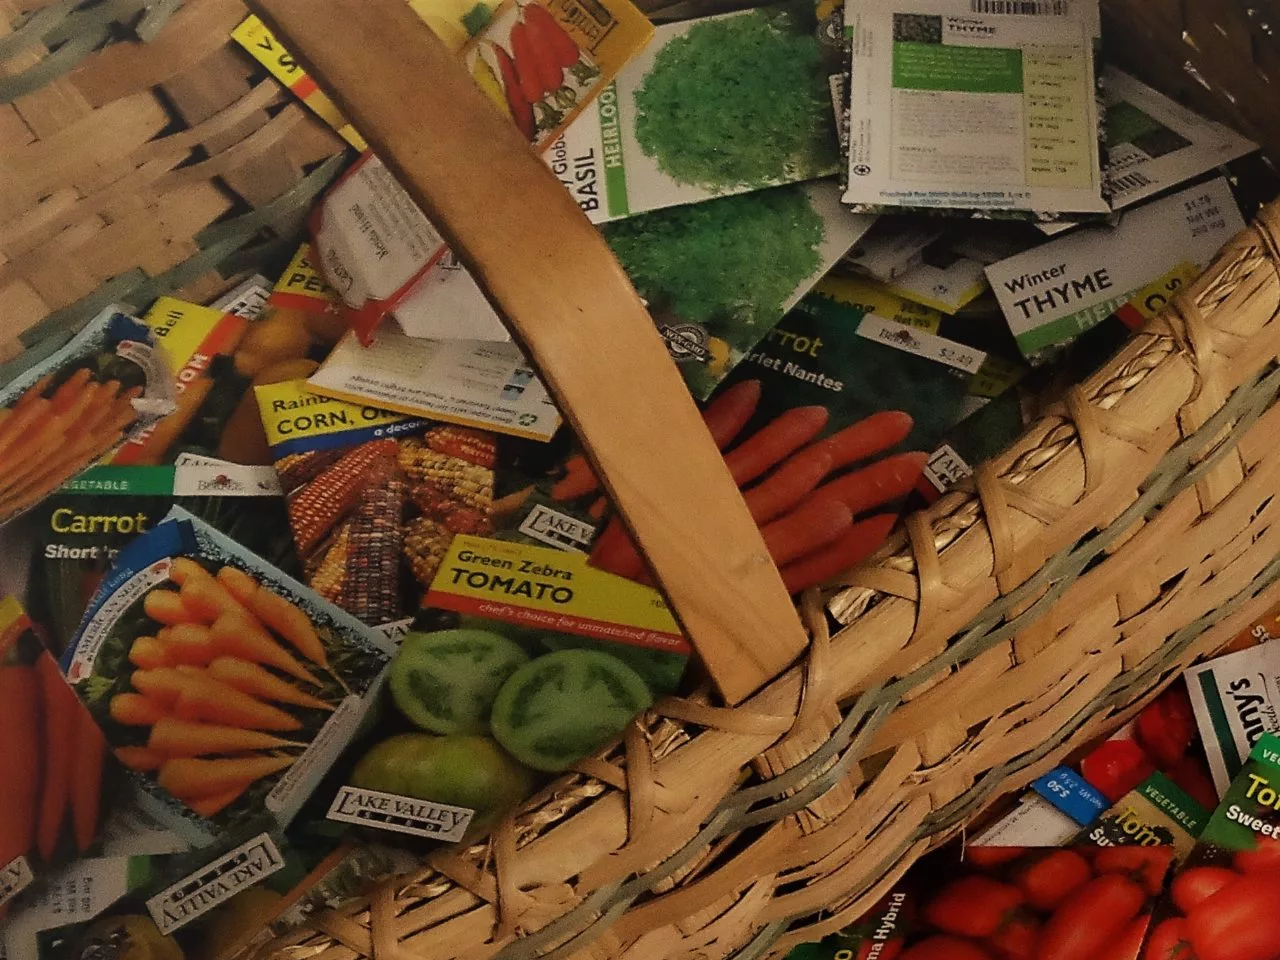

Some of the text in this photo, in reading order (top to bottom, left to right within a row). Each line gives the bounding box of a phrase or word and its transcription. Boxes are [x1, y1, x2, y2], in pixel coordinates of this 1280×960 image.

[574, 148, 598, 212] BASIL
[1004, 263, 1067, 292] Winter
[1014, 269, 1113, 320] THYME
[782, 361, 844, 392] Nantes
[277, 411, 354, 435] CORN,
[51, 507, 149, 535] Carrot
[529, 510, 583, 535] LAKE
[44, 543, 100, 560] Short
[458, 550, 573, 581] Green Zebra
[451, 568, 574, 604] TOMATO
[334, 791, 470, 836] LAKE VALLEY
[1144, 784, 1198, 829] VEGETABLE
[1225, 805, 1280, 845] Sweet
[1114, 807, 1163, 846] Tom
[153, 842, 277, 928] LAKE VALLEY
[878, 892, 907, 942] Hybrid
